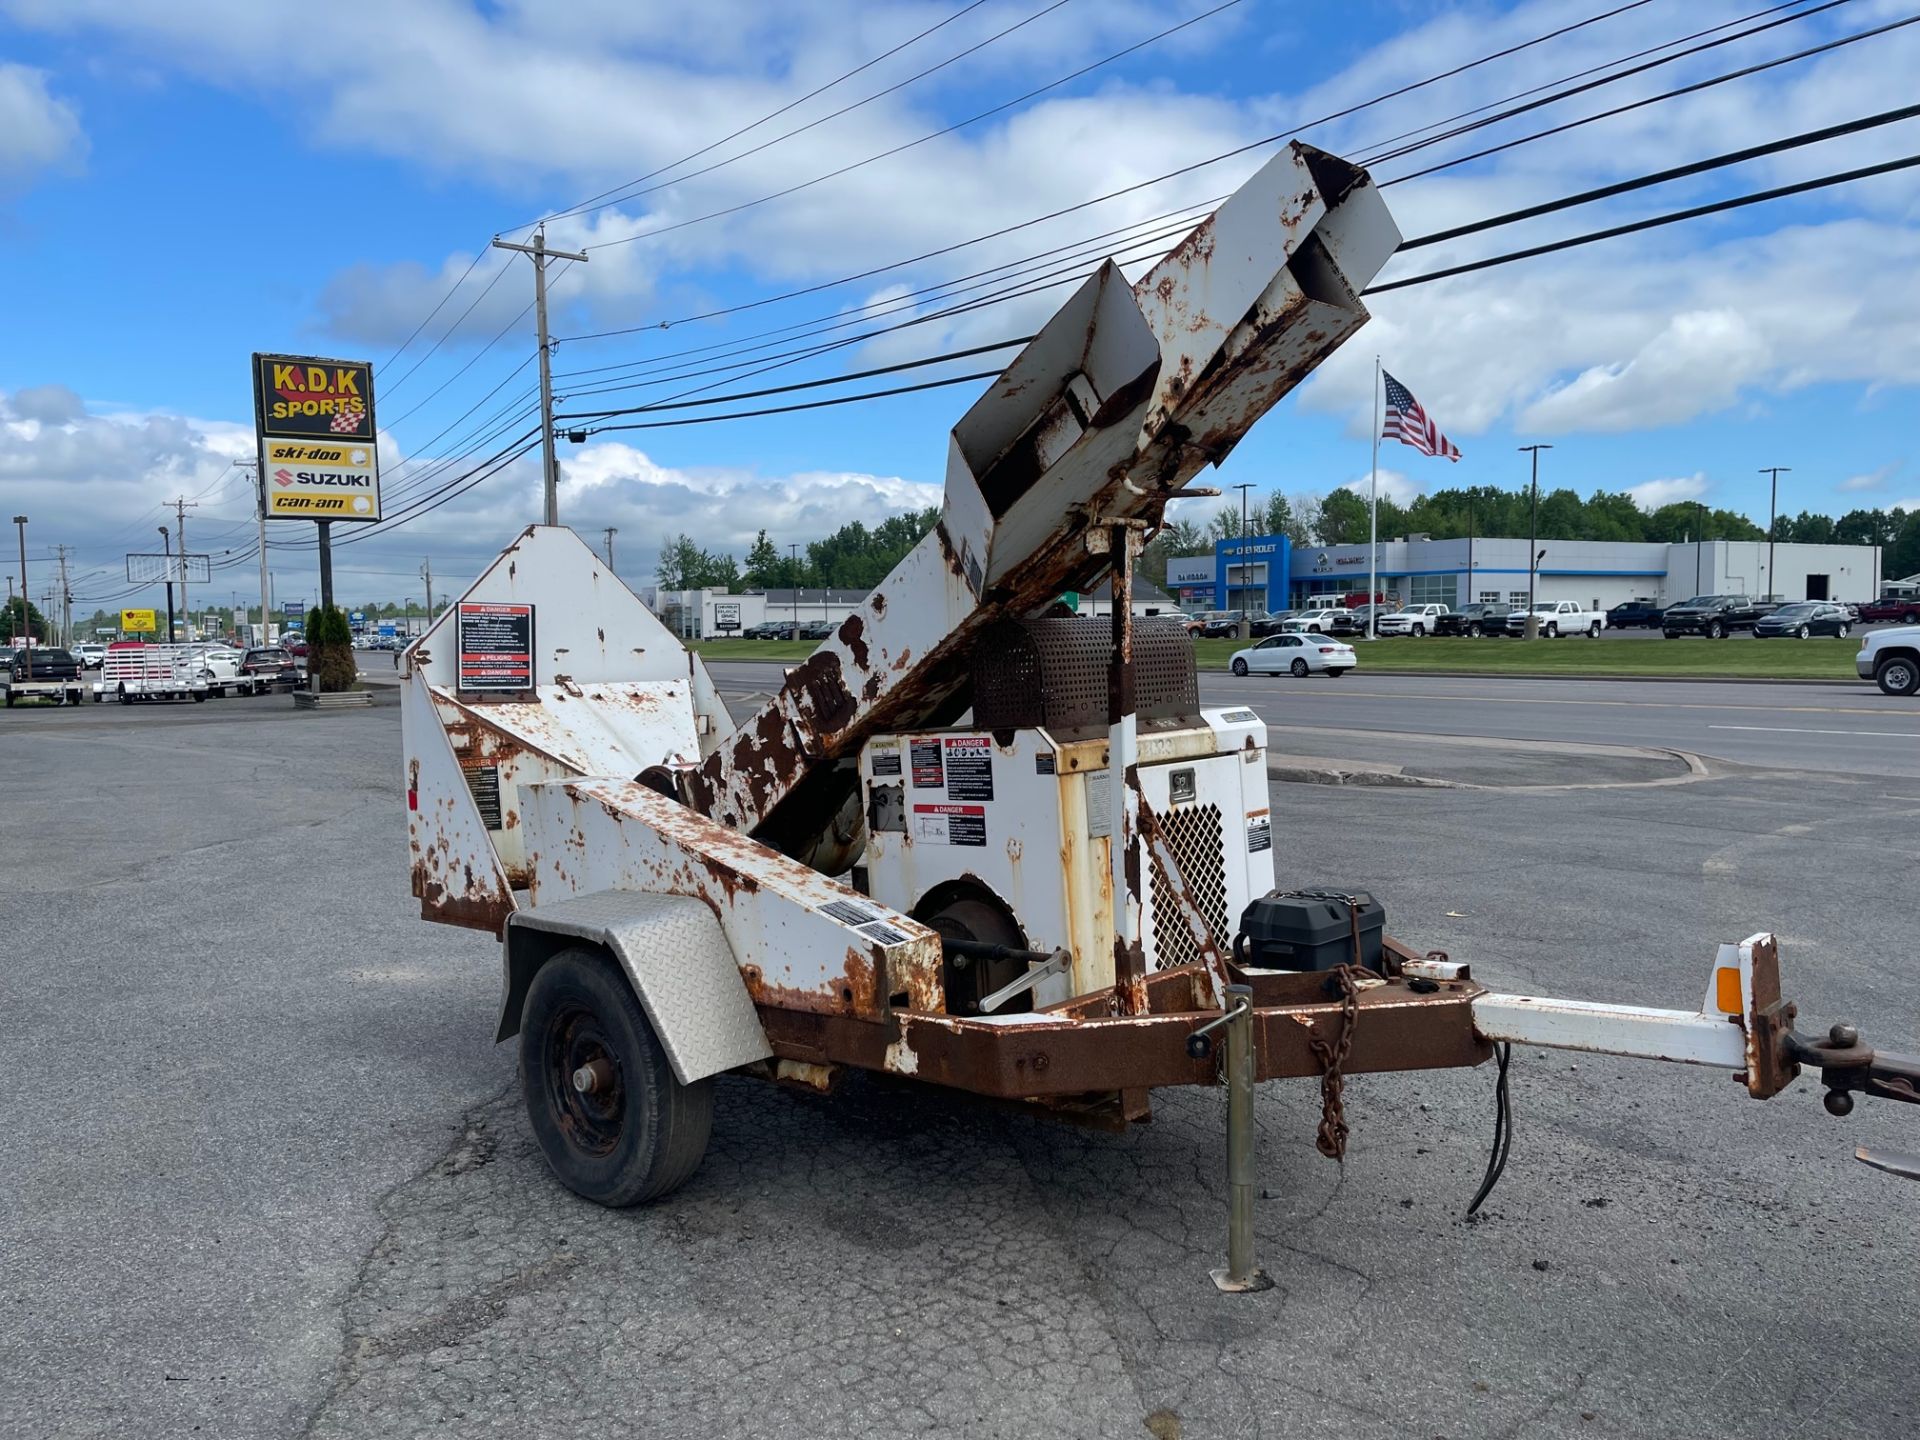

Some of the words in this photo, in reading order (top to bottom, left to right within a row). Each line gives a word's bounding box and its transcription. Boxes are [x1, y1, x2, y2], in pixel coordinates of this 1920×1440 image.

[273, 364, 360, 395] K.D.K
[272, 397, 364, 418] SPORTS
[273, 446, 342, 461] ski-doo
[297, 472, 370, 487] SUZUKI
[276, 497, 344, 509] can-am
[957, 739, 985, 747] DANGER
[939, 806, 964, 814] DANGER
